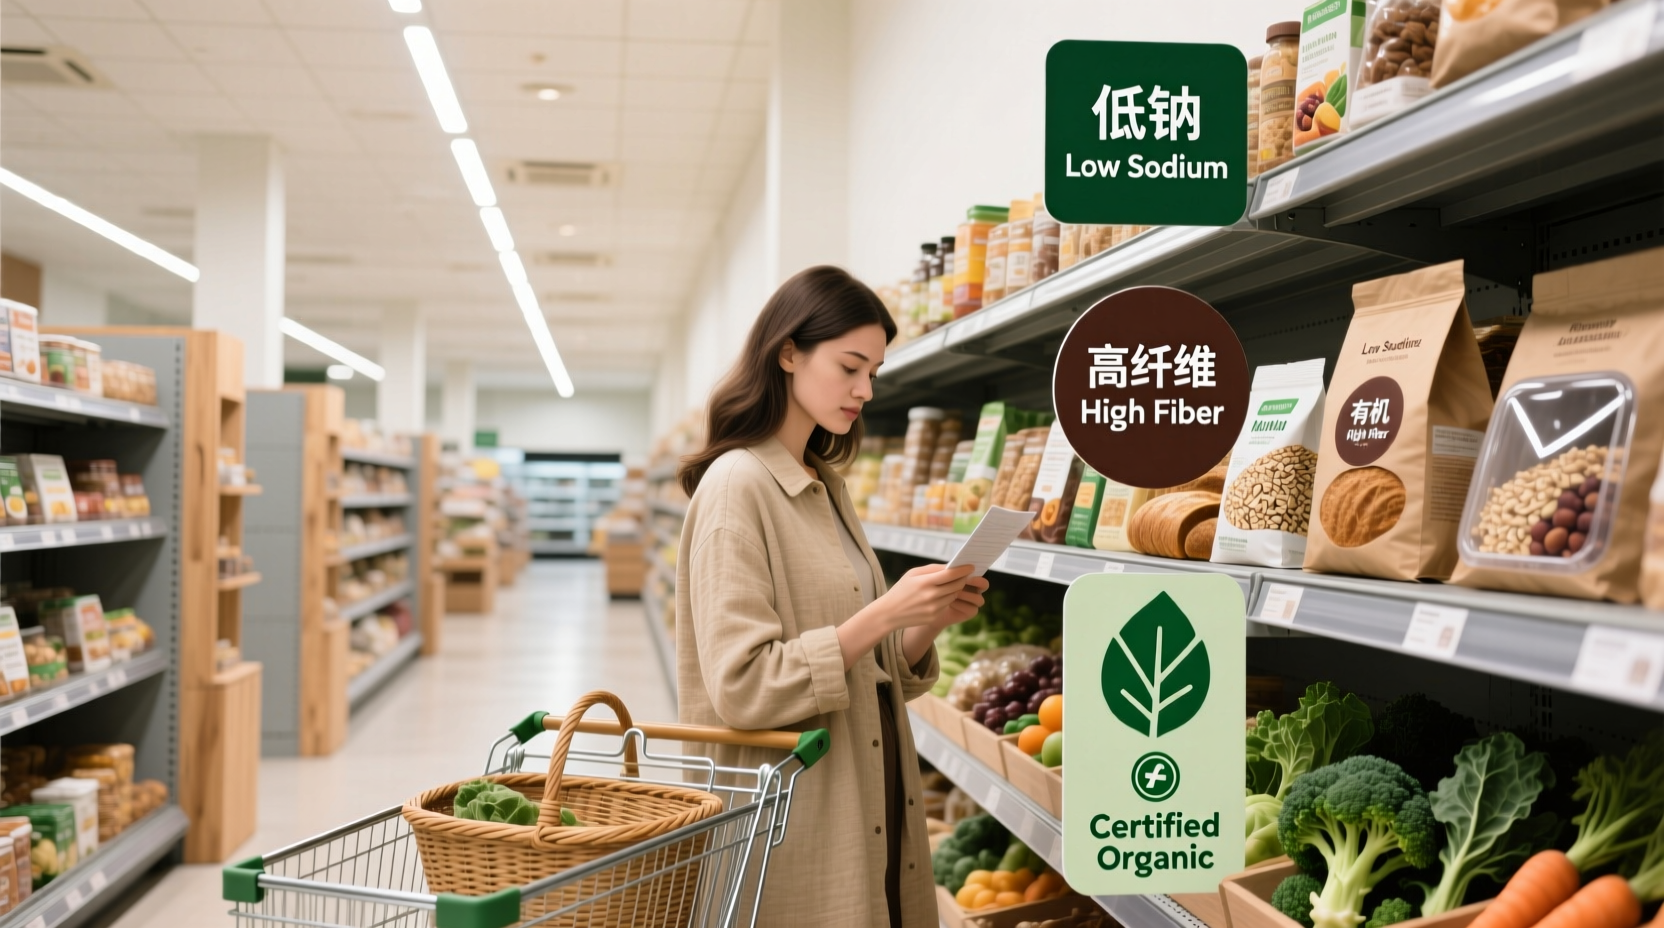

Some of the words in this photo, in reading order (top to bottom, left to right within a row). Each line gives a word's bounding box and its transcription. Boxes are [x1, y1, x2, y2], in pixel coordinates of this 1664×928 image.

[1091, 84, 1201, 141] 低钠
[1066, 153, 1121, 178] Low
[1128, 153, 1228, 179] Sodium
[1087, 343, 1217, 389] 高纤维
[1081, 398, 1145, 432] High
[1154, 398, 1225, 425] Fiber
[1350, 397, 1390, 426] 有机
[1089, 811, 1220, 840] Certified
[1097, 843, 1215, 878] Organic
